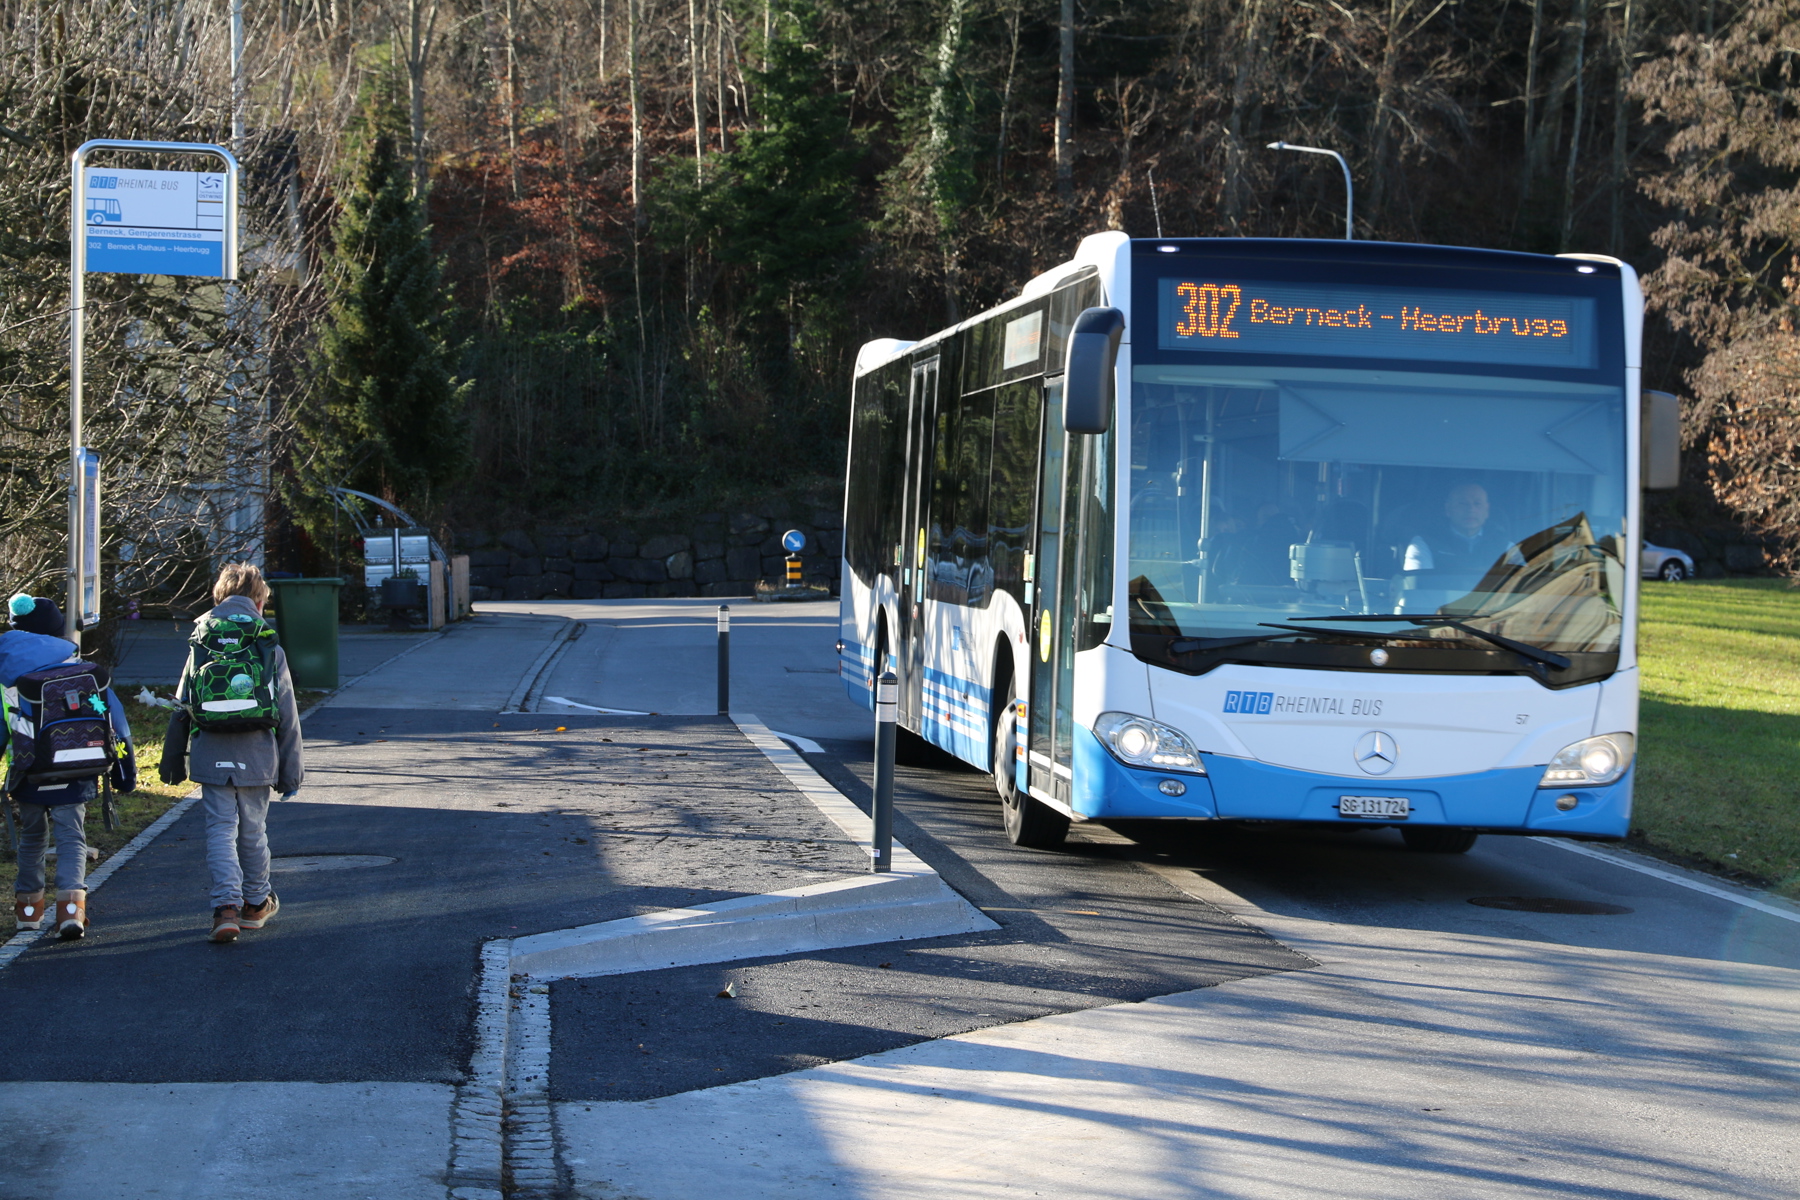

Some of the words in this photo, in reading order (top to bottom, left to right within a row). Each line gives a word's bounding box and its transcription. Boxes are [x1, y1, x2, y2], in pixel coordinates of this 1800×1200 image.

[90, 176, 117, 188] RTB
[118, 179, 157, 190] RHEINTAL
[161, 181, 179, 191] BUS
[89, 227, 126, 236] Berneck,
[128, 229, 202, 239] Gemperenstrasse
[137, 244, 166, 252] Rathaus
[173, 245, 210, 255] Heerbrugg
[1177, 282, 1241, 338] 302
[1251, 299, 1373, 328] Berneck
[1401, 306, 1568, 338] Heerbrugg
[1224, 691, 1273, 714] RTB
[1274, 695, 1345, 715] RHEINTAL
[1351, 698, 1383, 716] BUS
